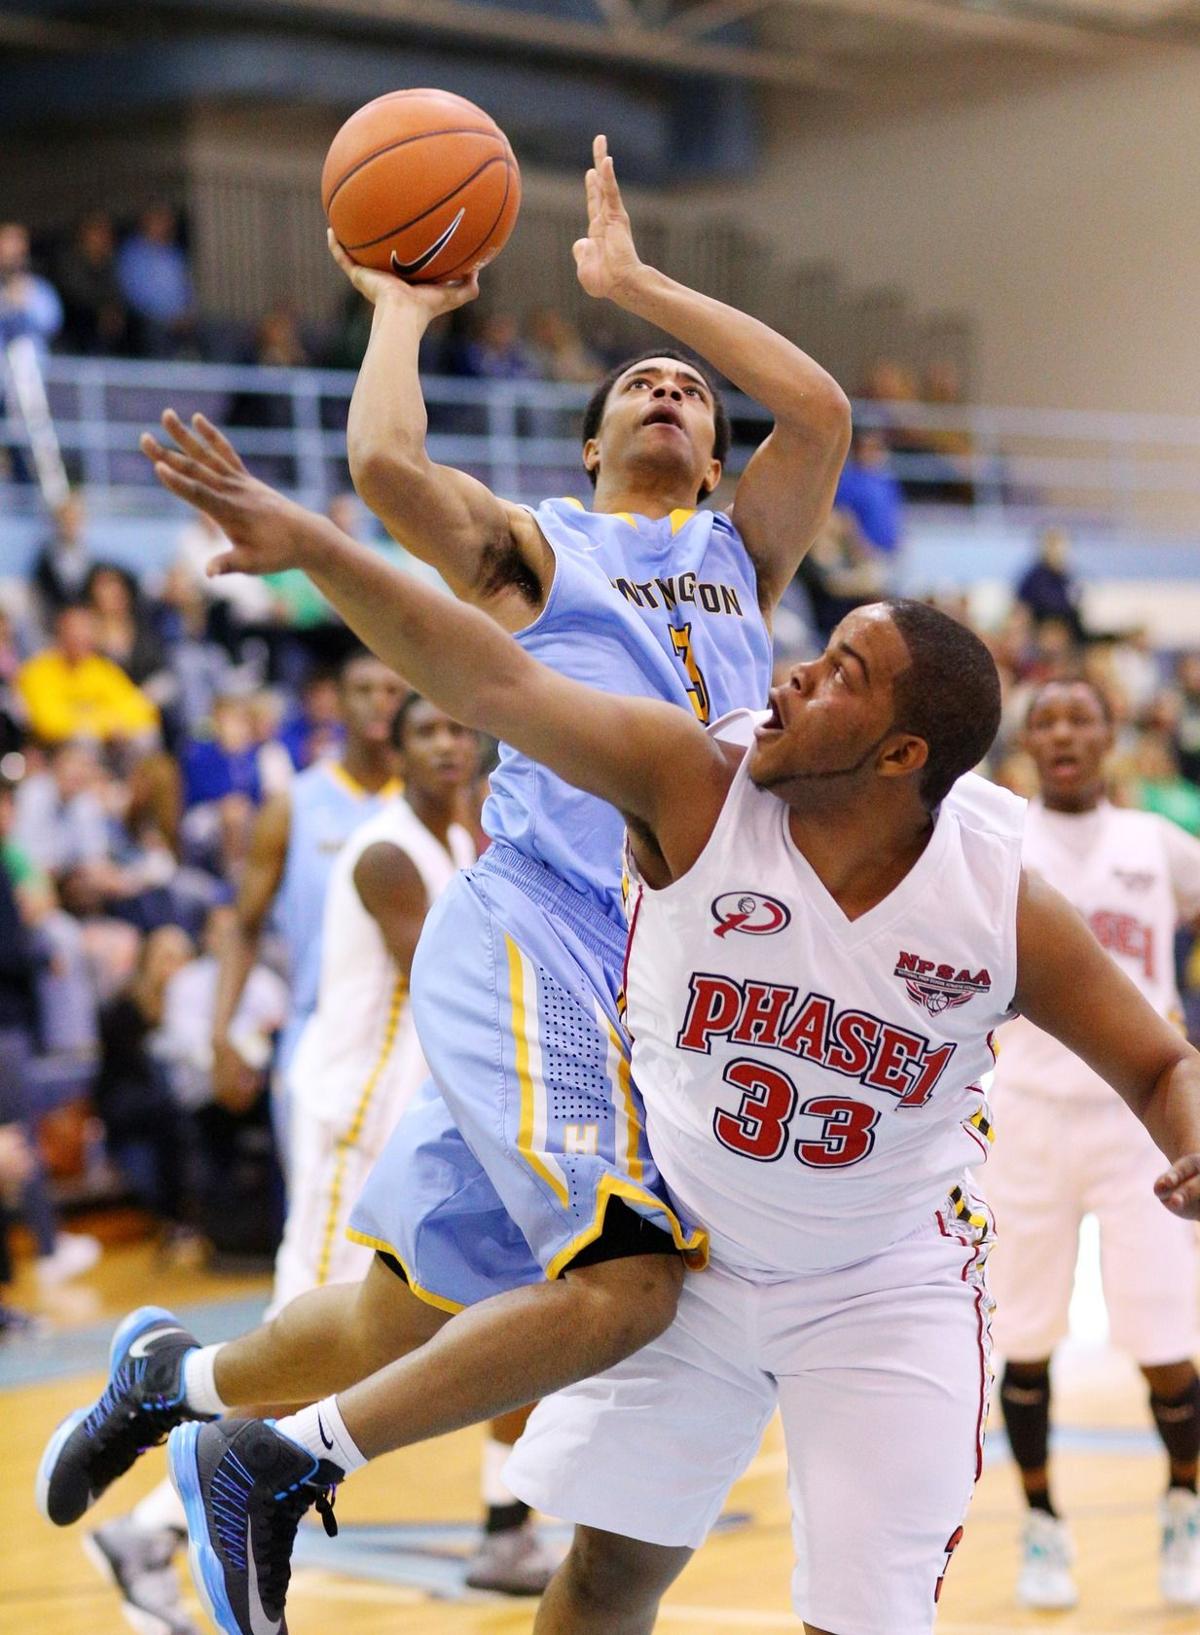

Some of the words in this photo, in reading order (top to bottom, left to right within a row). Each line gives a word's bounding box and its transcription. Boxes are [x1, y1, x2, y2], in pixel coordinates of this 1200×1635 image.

[895, 950, 992, 986] NPSAA
[675, 971, 958, 1111] PHASE1
[564, 1123, 599, 1155] H
[712, 1056, 882, 1169] 33
